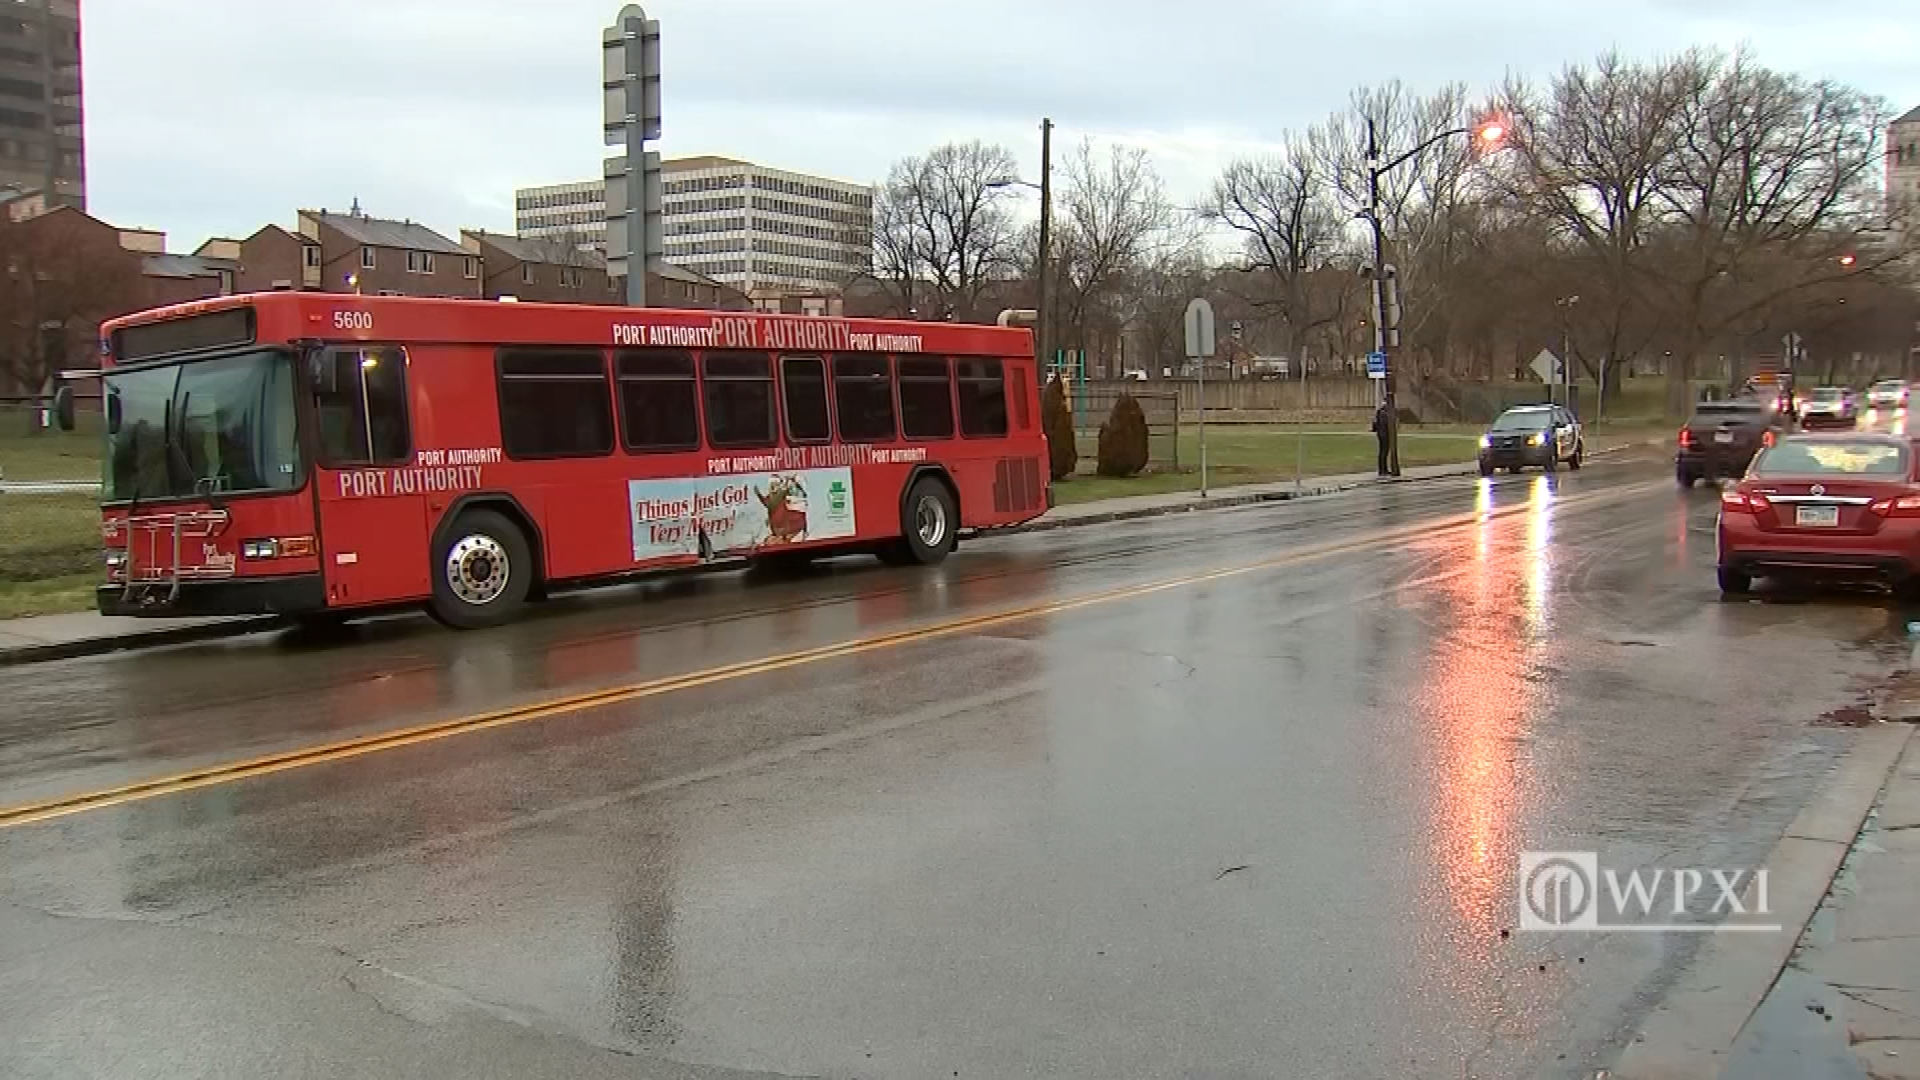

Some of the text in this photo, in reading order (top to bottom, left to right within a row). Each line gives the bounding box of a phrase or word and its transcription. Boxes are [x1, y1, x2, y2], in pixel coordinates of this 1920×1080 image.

[334, 311, 373, 329] 5600
[613, 323, 713, 347] PORT AUTHORITY
[711, 317, 850, 349] PORT AUTHORITY
[850, 333, 923, 352] PORT AUTHORITY
[418, 448, 502, 466] PORT AUTHORITY
[708, 455, 777, 473] PORT AUTHORITY
[775, 443, 873, 469] PORT AUTHORITY
[872, 449, 890, 464] PORT
[340, 466, 482, 497] PORT AUTHORITY
[636, 484, 748, 523] Things Just Got
[650, 510, 737, 543] Very Merry!
